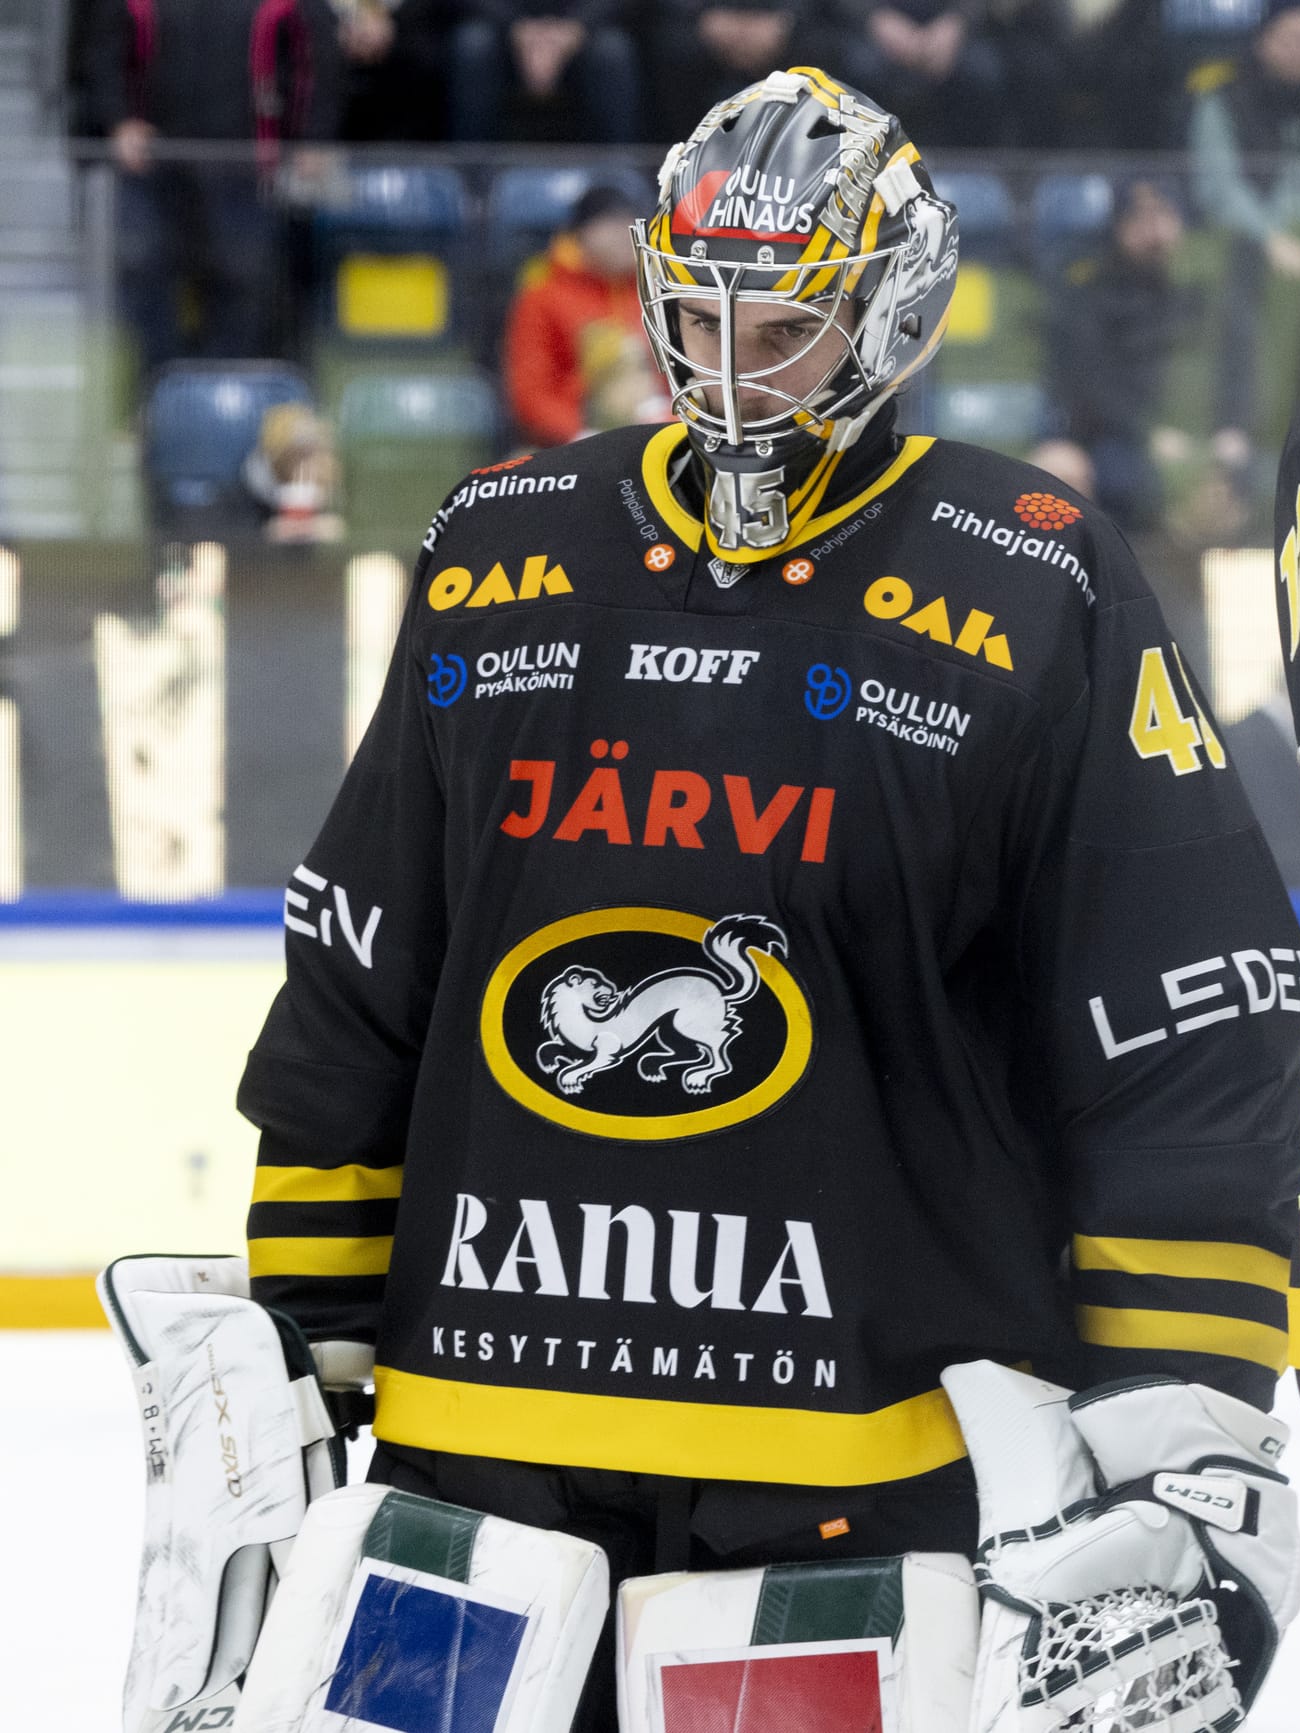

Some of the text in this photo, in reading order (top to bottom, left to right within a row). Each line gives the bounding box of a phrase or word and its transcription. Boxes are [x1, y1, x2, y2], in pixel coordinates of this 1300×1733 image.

[726, 164, 795, 202] OULU
[708, 199, 815, 234] HINAUS
[617, 478, 659, 542] Pohjolan OP
[710, 465, 790, 550] 45
[810, 501, 884, 561] Pohjolan OP
[428, 554, 574, 611] OAK
[863, 576, 1014, 672] OAK
[475, 672, 574, 699] PYSÄKÖINTI
[476, 642, 581, 678] OULUN
[624, 644, 760, 684] KOFF
[856, 706, 960, 756] PYSÄKÖINTI
[860, 679, 971, 737] OULUN
[500, 739, 836, 863] JÄRVI
[432, 1326, 836, 1388] KESYTTÄMÄTÖN
[1165, 1484, 1234, 1509] CCM
[164, 1706, 236, 1733] CM
